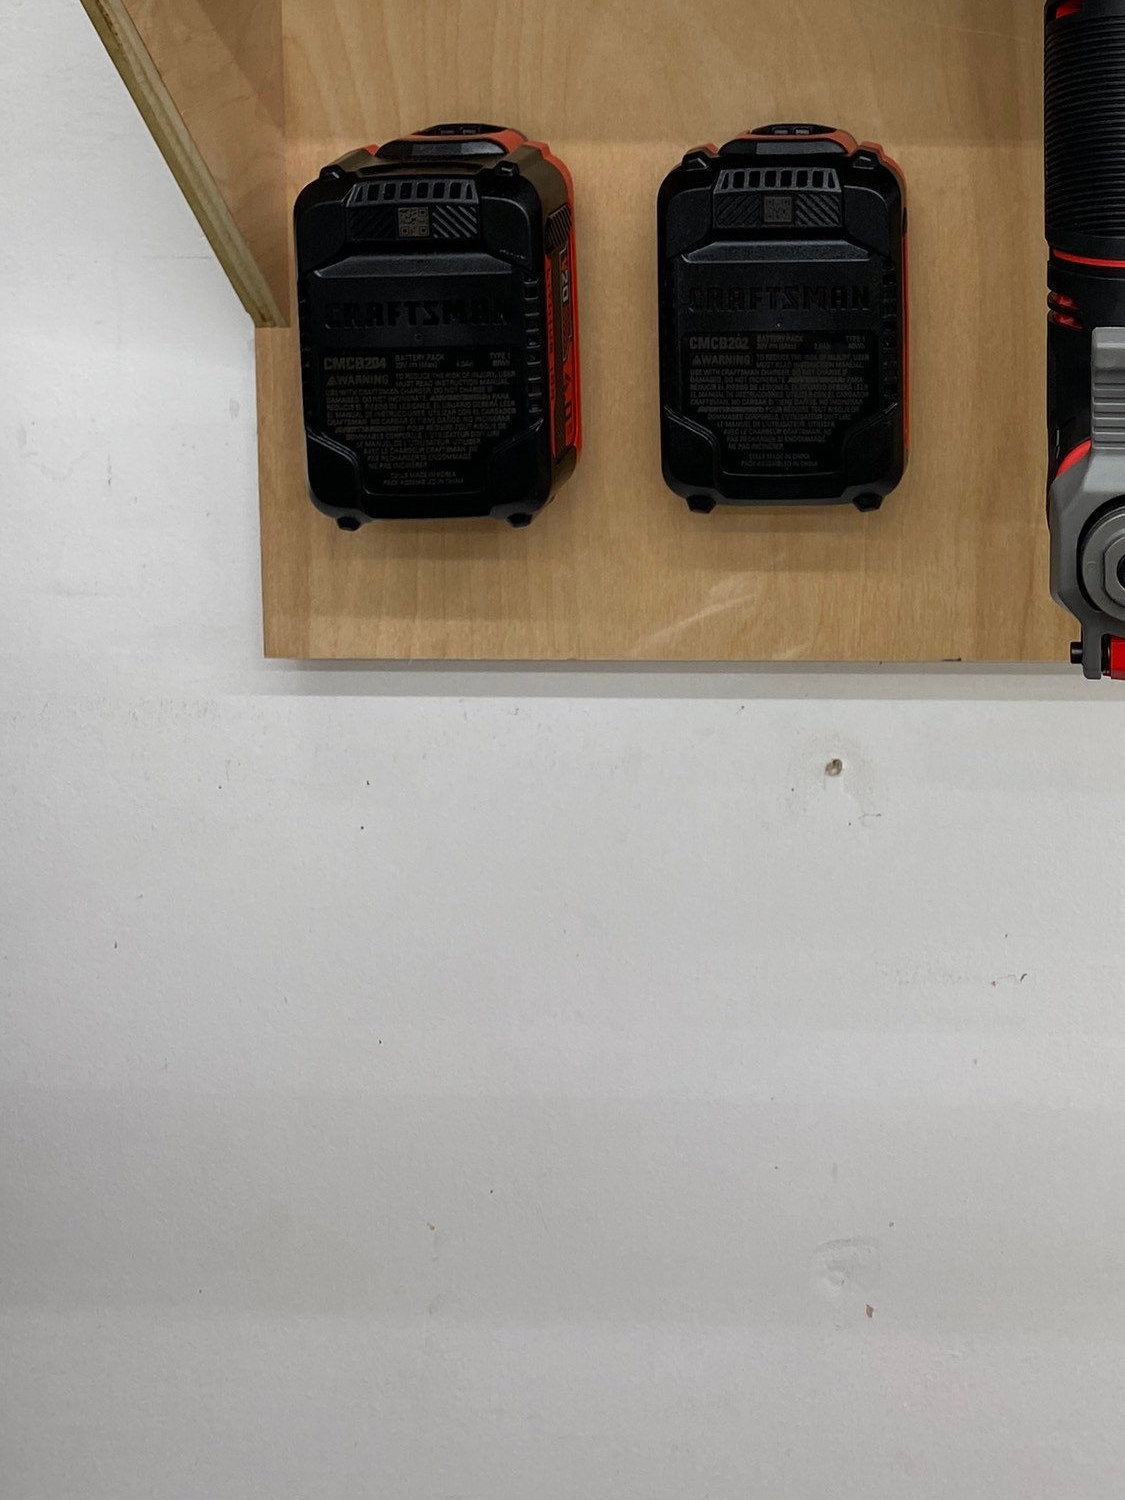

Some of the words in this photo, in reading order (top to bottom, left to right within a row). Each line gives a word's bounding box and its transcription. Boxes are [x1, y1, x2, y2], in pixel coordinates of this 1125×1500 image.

[688, 285, 871, 312] CRAFTSMAN
[324, 299, 512, 329] CRAFTSMAN
[689, 336, 749, 350] CMCB202
[323, 355, 387, 371] CMCB204
[701, 354, 750, 365] WARNING
[337, 374, 389, 385] WARNING
